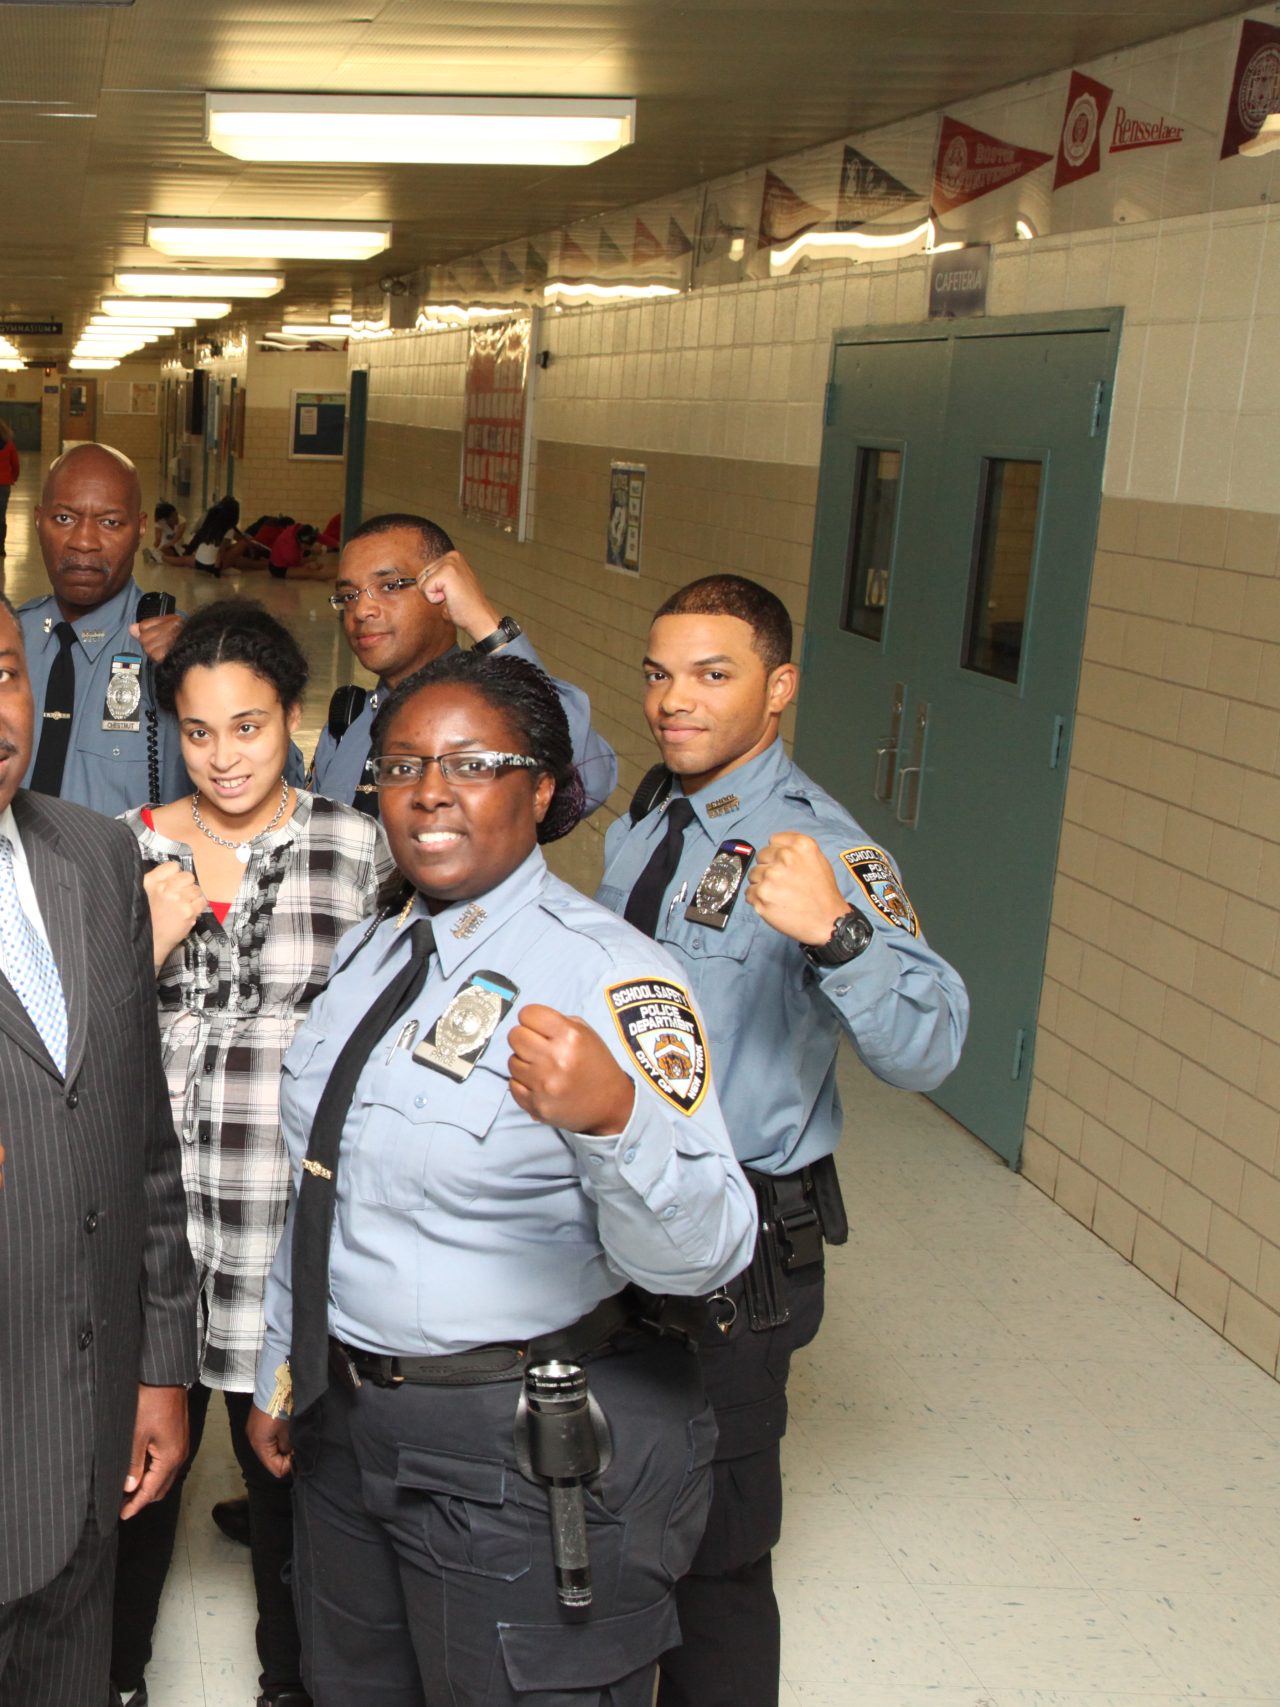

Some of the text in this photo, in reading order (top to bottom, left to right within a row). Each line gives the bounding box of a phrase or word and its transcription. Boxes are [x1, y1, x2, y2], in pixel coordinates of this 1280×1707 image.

[1112, 106, 1184, 145] Rensselaer
[935, 270, 982, 292] CAFETERIA
[845, 850, 877, 864] SCHOOL
[870, 894, 903, 926] CITY OF
[612, 984, 688, 1007] SCHOOL SAFETY
[640, 1003, 682, 1019] POLICE
[628, 1016, 695, 1036] DEPARTMENT
[635, 1050, 674, 1094] CITY OF
[687, 1044, 704, 1100] NEW YORK
